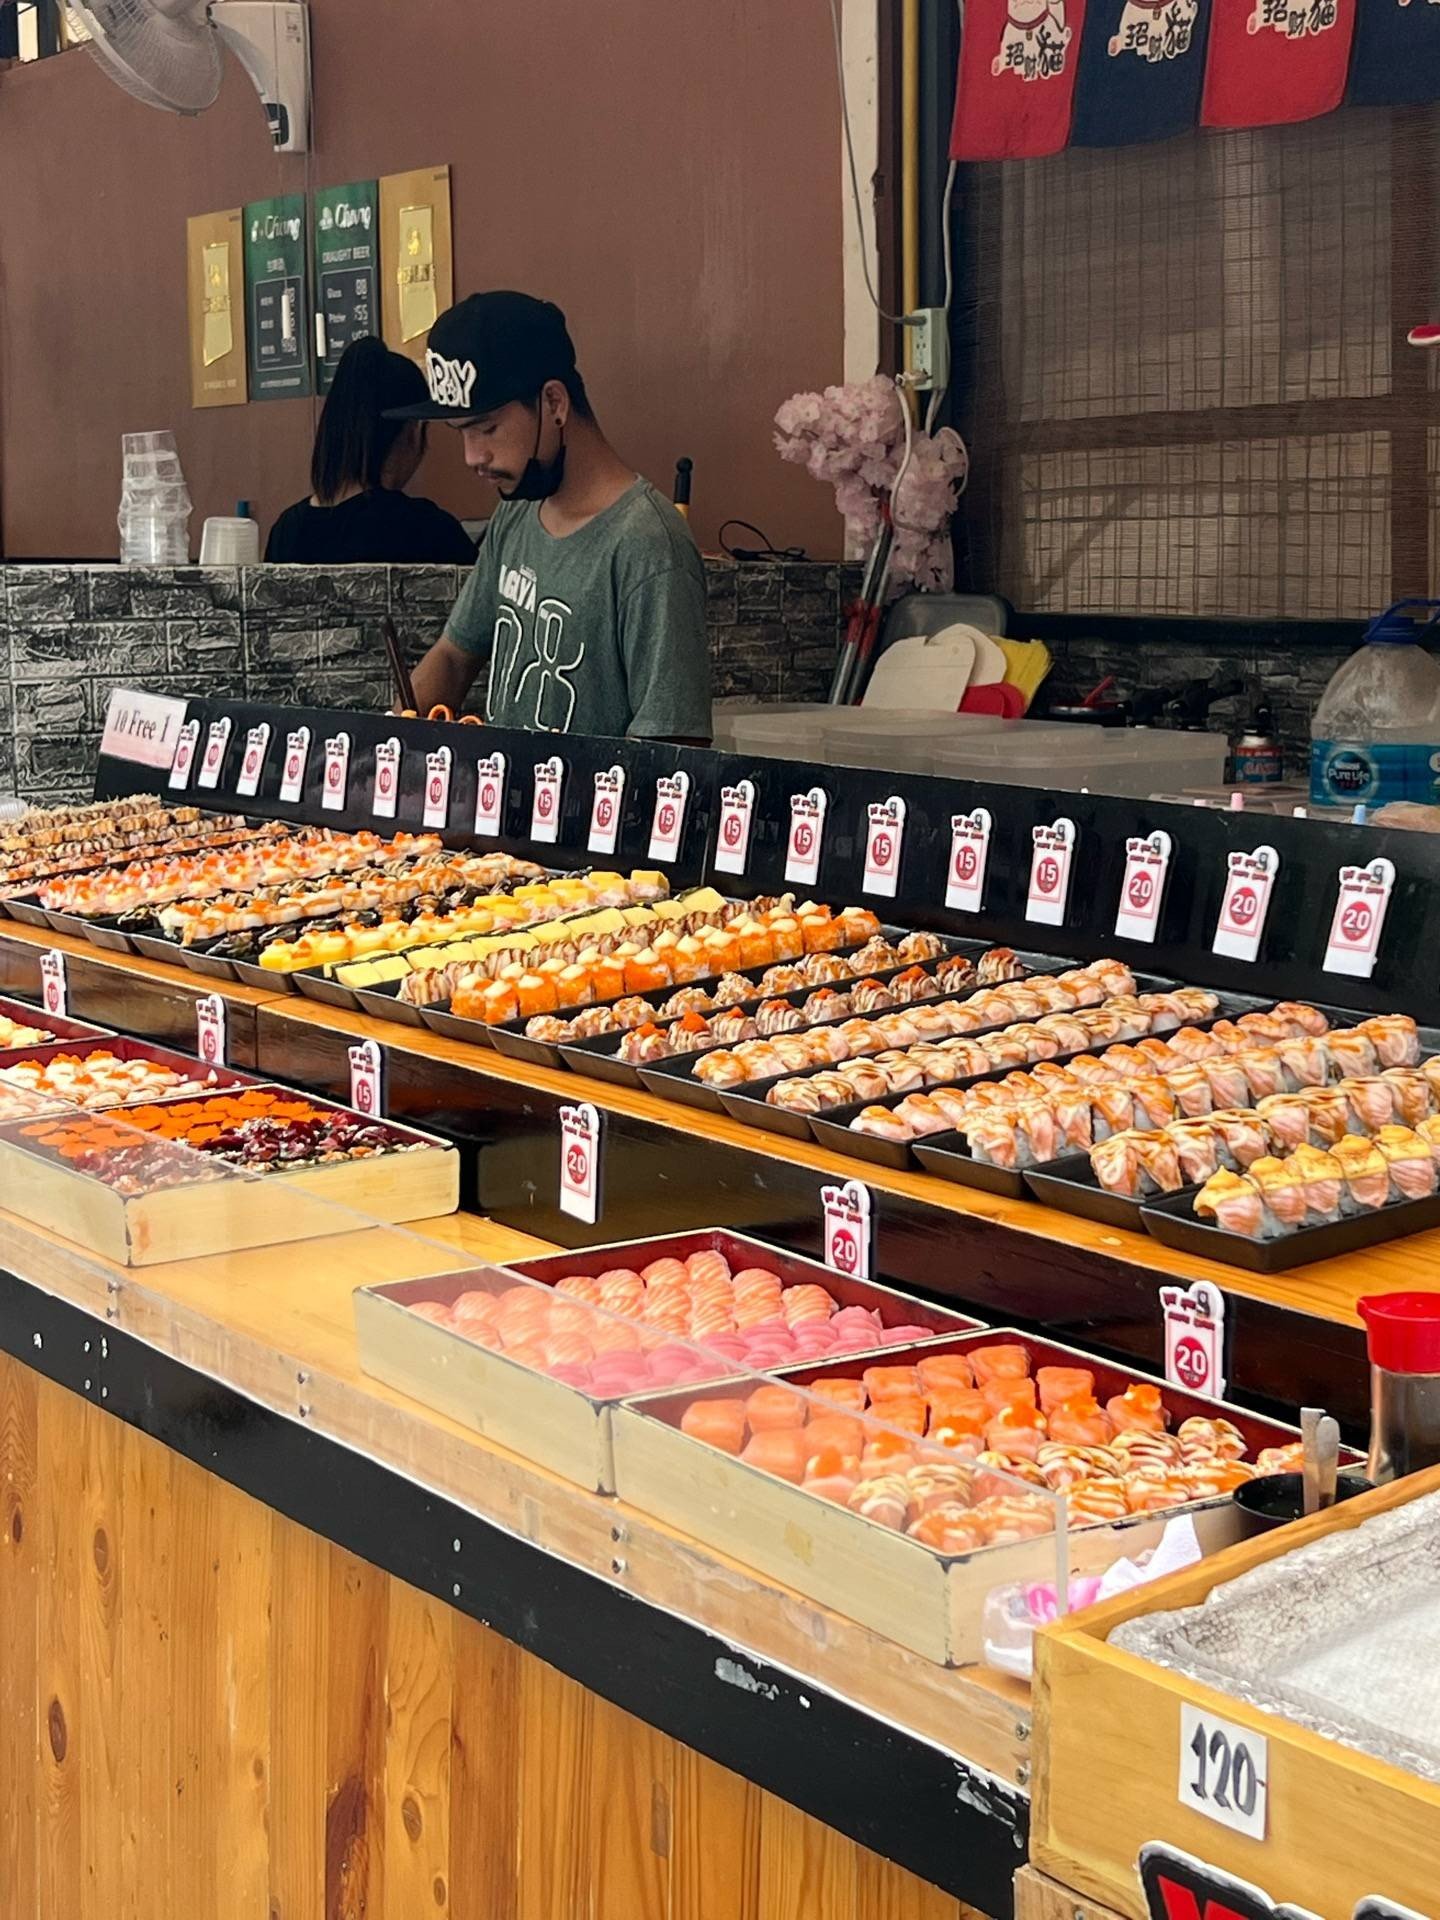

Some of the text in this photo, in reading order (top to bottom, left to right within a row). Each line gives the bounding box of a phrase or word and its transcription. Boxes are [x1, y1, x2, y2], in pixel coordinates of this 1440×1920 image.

[128, 709, 157, 740] Free
[1328, 768, 1351, 780] Pure
[539, 793, 551, 809] 15
[599, 802, 612, 818] 15
[661, 809, 674, 826] 15
[726, 819, 741, 836] 15
[796, 828, 811, 846] 15
[873, 838, 890, 857] 15
[957, 850, 975, 871] 15
[1040, 860, 1057, 881] 15
[1130, 879, 1151, 898] 20
[1231, 893, 1256, 915] 20
[1343, 908, 1371, 930] 20
[204, 1034, 215, 1053] 15
[358, 1084, 371, 1105] 15
[568, 1151, 586, 1174] 20
[834, 1236, 856, 1262] 20
[1176, 1344, 1207, 1376] 20
